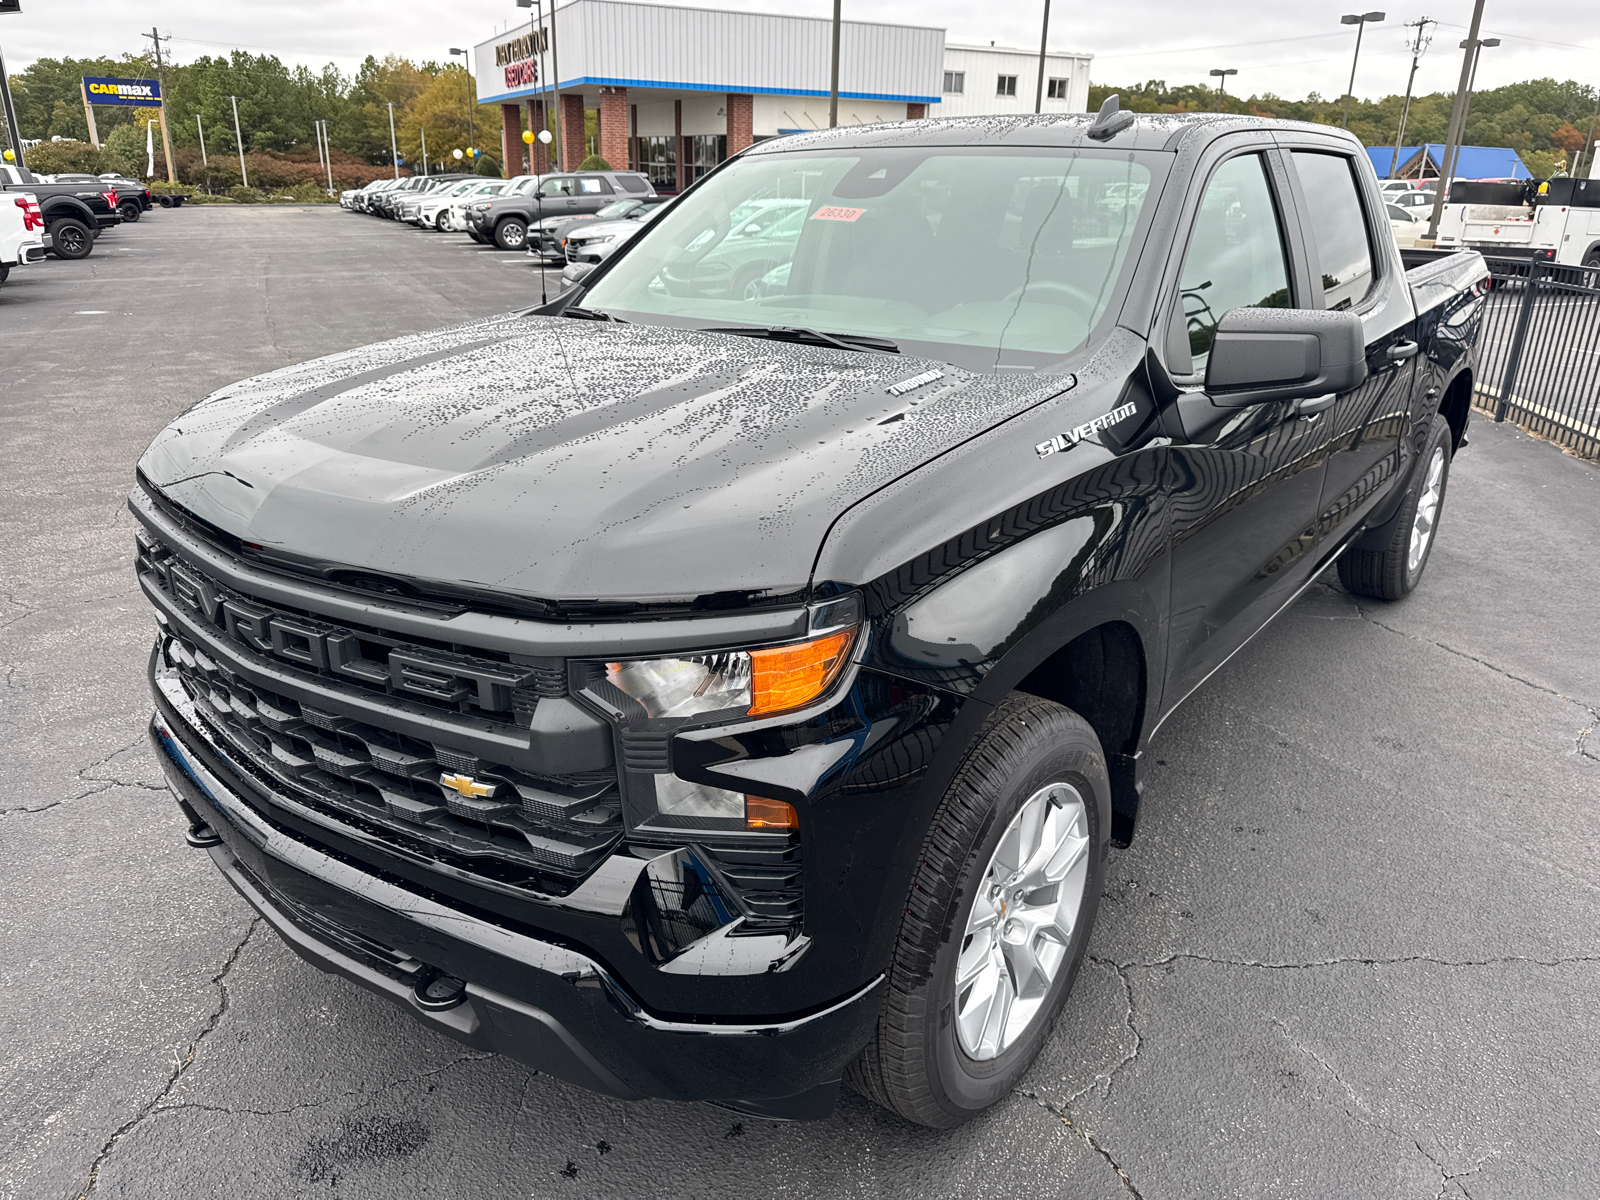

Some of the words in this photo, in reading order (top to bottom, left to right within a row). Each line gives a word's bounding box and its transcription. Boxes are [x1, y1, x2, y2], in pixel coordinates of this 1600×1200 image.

[504, 64, 520, 88] USED
[519, 59, 538, 84] CARS
[820, 207, 857, 219] 26330
[884, 367, 945, 397] TURBOMAX
[1035, 401, 1138, 459] SILVERADO
